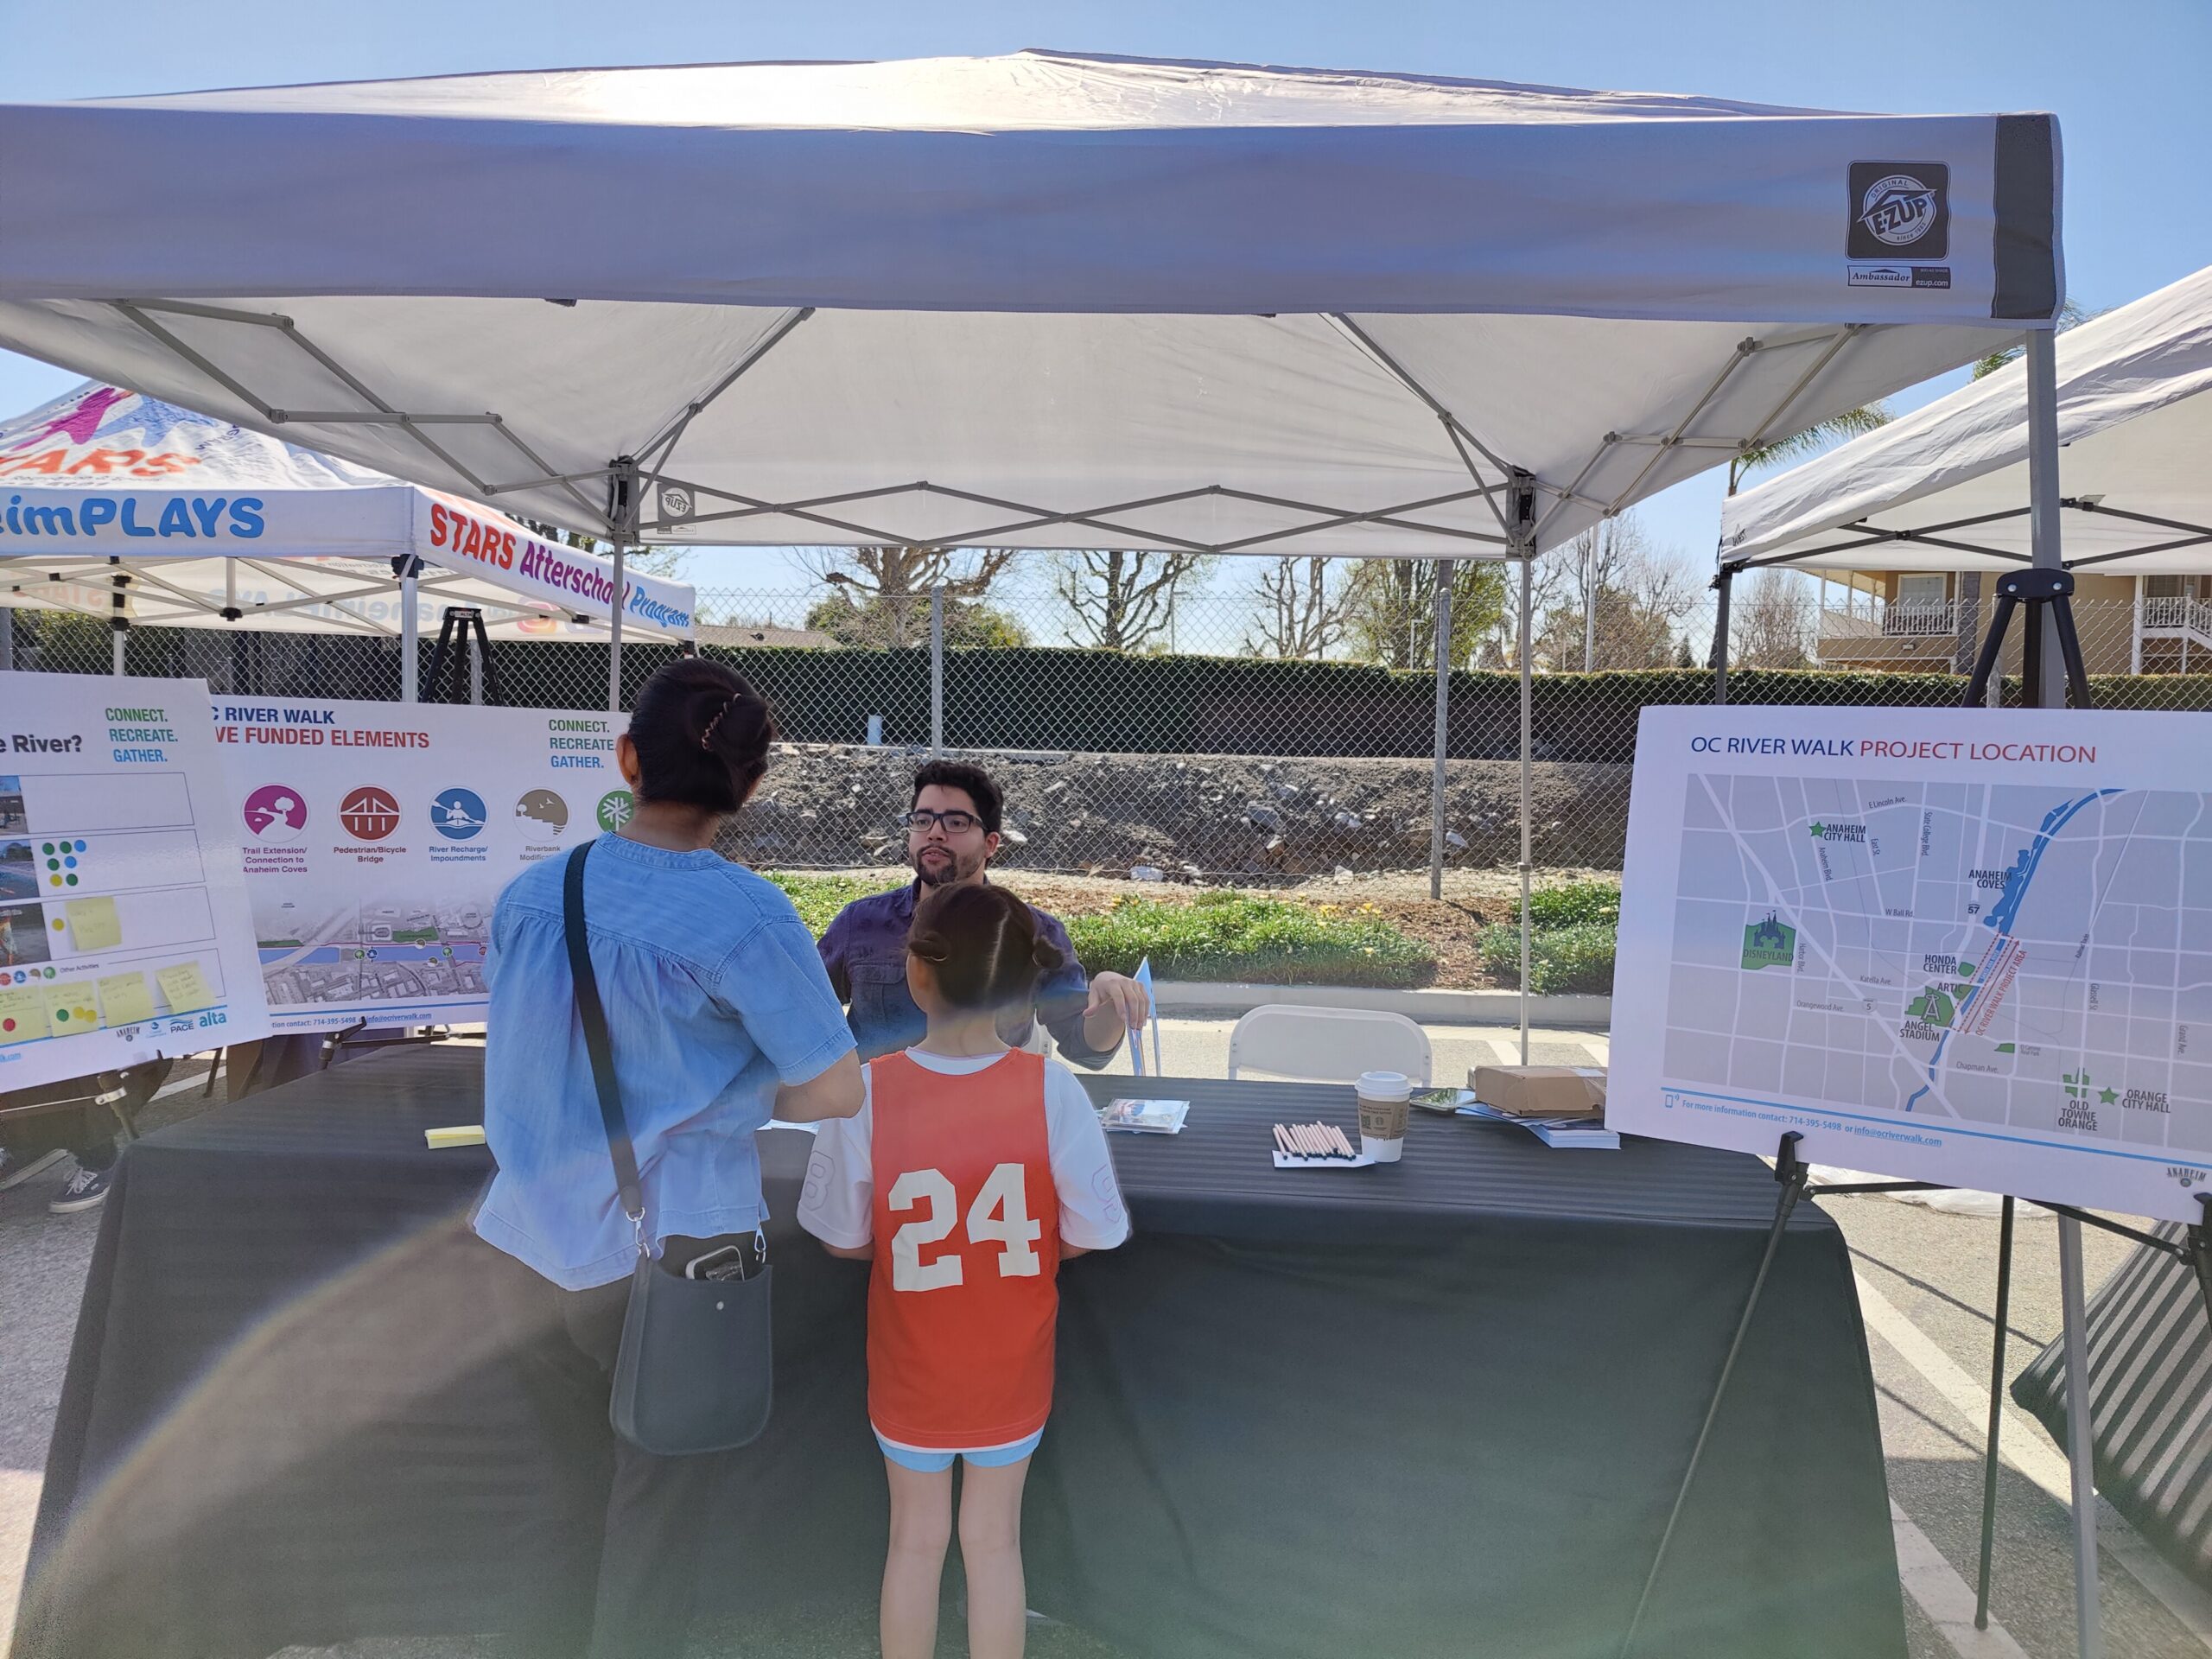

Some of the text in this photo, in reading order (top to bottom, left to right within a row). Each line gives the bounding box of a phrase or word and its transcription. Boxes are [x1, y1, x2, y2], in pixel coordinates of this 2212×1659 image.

[1871, 180, 1908, 198] ORIGINAL
[1853, 271, 1910, 282] Ambassador
[1916, 279, 1948, 288] ezup.com
[0, 495, 264, 538] imPLAYS
[430, 504, 690, 627] STARS Afterschol Program
[105, 708, 168, 722] CONNECT.
[225, 707, 278, 722] RIVER
[283, 709, 335, 724] WALK
[549, 719, 610, 733] CONNECT.
[109, 728, 178, 742] RECREATE.
[245, 728, 324, 745] FUNDED
[331, 730, 429, 748] ELEMENTS
[12, 734, 82, 753] River?
[1691, 736, 2096, 763] OC RIVER WALK PROJECT LOCATION
[113, 749, 168, 762] GATHER.
[550, 755, 604, 768] GATHER.
[1873, 798, 1894, 809] Lincoln
[1923, 811, 1933, 824] State
[1826, 823, 1866, 835] ANAHEIM
[1921, 823, 1931, 844] College
[1824, 832, 1866, 842] CITY HALL
[1871, 838, 1879, 849] East
[334, 846, 407, 855] Pedestrian/Bicycle
[1819, 847, 1828, 869] Anaheim
[1968, 869, 2012, 881] ANAHEIM
[1977, 880, 2005, 889] COVES
[1743, 950, 1794, 962] DISNEYLAND
[1925, 954, 1956, 965] HONDA
[1923, 963, 1957, 975] CENTER
[1860, 975, 1879, 984] Katella
[1937, 982, 1964, 994] ARTIC
[1975, 950, 2027, 1036] OC RIVER WALK PROJECT AREA
[1796, 1001, 1832, 1011] Orangewood
[170, 1023, 194, 1033] PACE
[199, 1012, 227, 1027] alta
[313, 1017, 356, 1026] 714-395-5498
[366, 1013, 431, 1024] info@ocriverwalk.com
[1904, 1020, 1934, 1033] ANGEL
[1899, 1029, 1940, 1042] STADIUM
[1956, 1061, 1985, 1071] Chapman
[2126, 1090, 2167, 1103] ORANGE
[2069, 1100, 2088, 1111] OLD
[2122, 1098, 2171, 1113] CITY HALL
[2061, 1108, 2096, 1122] TOWNE
[1682, 1100, 1693, 1109] For
[1694, 1103, 1713, 1112] more
[1714, 1106, 1756, 1118] information
[1758, 1112, 1788, 1122] contact:
[1789, 1116, 1842, 1131] 714-395-5498
[1854, 1127, 1942, 1147] info@ocriverwalk.com
[2058, 1117, 2098, 1131] ORANGE
[2167, 1167, 2207, 1182] ANAHEIM
[887, 1163, 1041, 1292] 24
